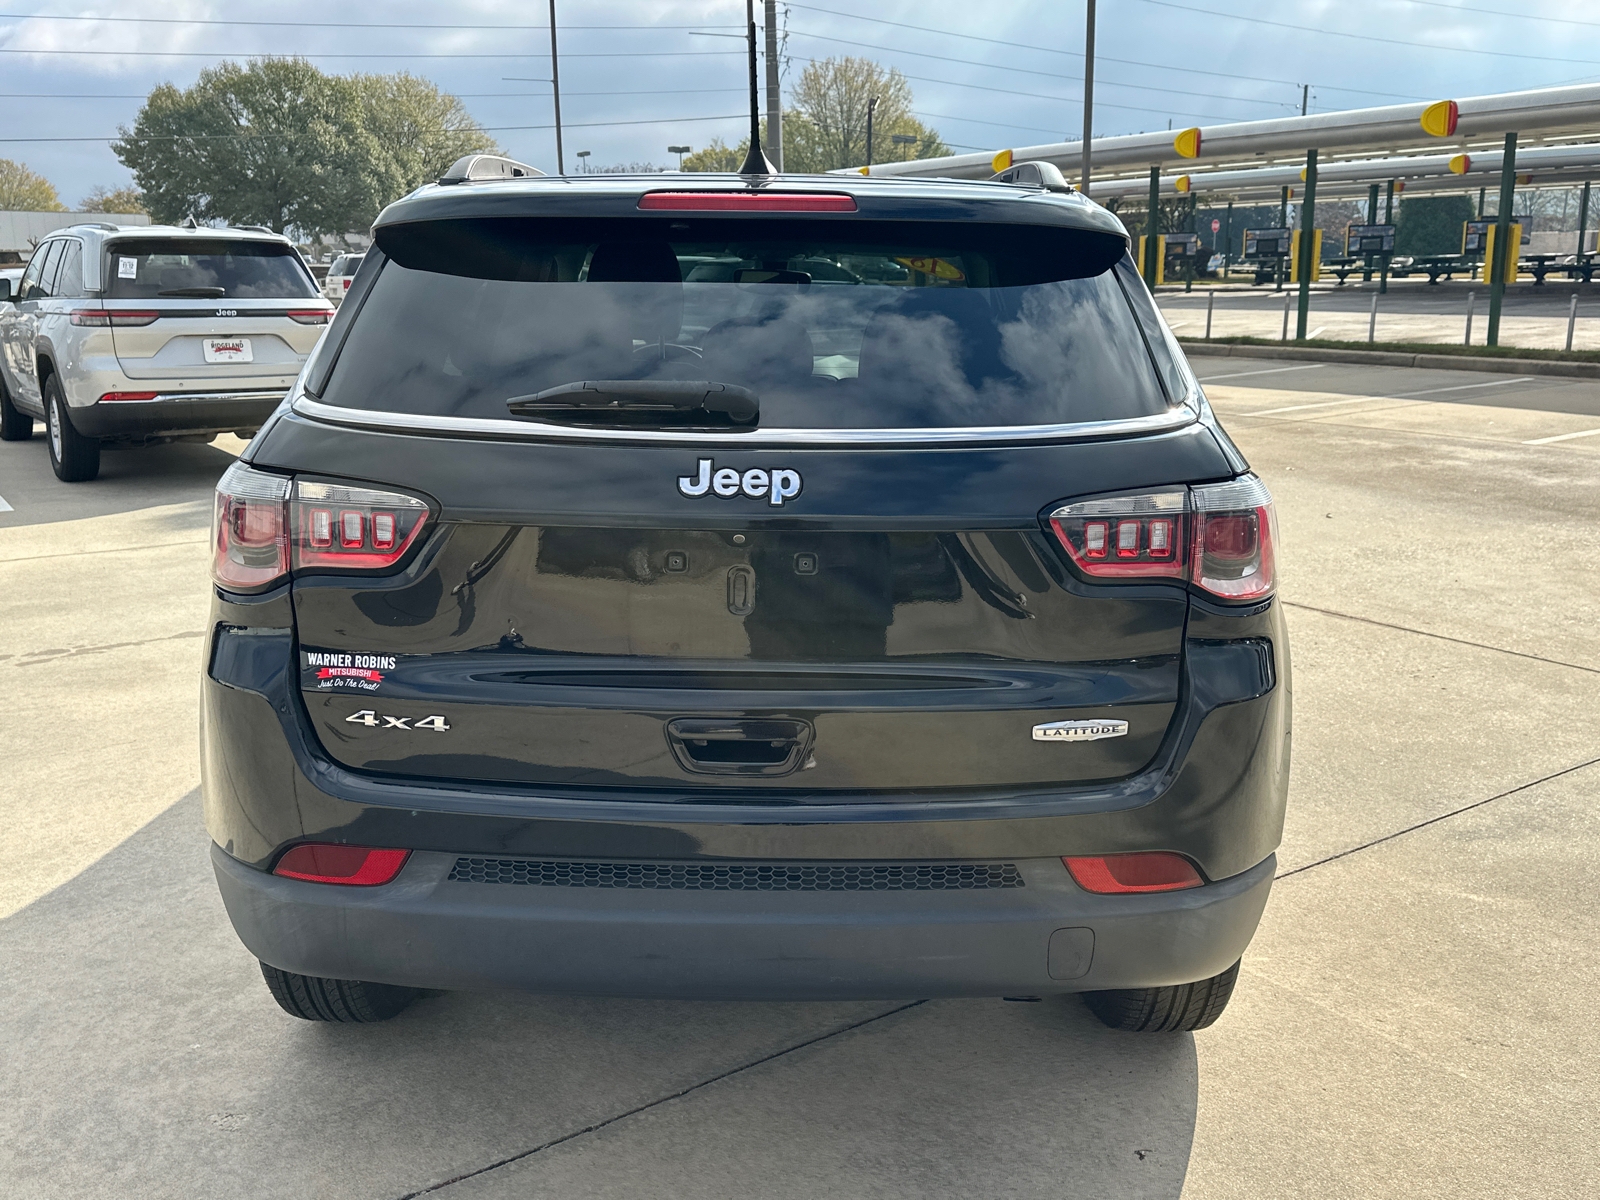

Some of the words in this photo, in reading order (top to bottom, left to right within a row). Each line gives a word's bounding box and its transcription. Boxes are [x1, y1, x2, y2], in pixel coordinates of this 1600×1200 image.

[216, 309, 237, 317] Jeep
[679, 459, 801, 505] Jeep
[307, 652, 352, 667] WARNER
[354, 655, 396, 670] ROBINS
[328, 667, 372, 678] MITSUBISHI
[317, 680, 334, 688] Just
[333, 678, 344, 687] Do
[344, 678, 358, 688] The
[358, 680, 380, 691] Deal!
[345, 709, 451, 732] 4x4
[1043, 726, 1119, 736] LATITUDE
